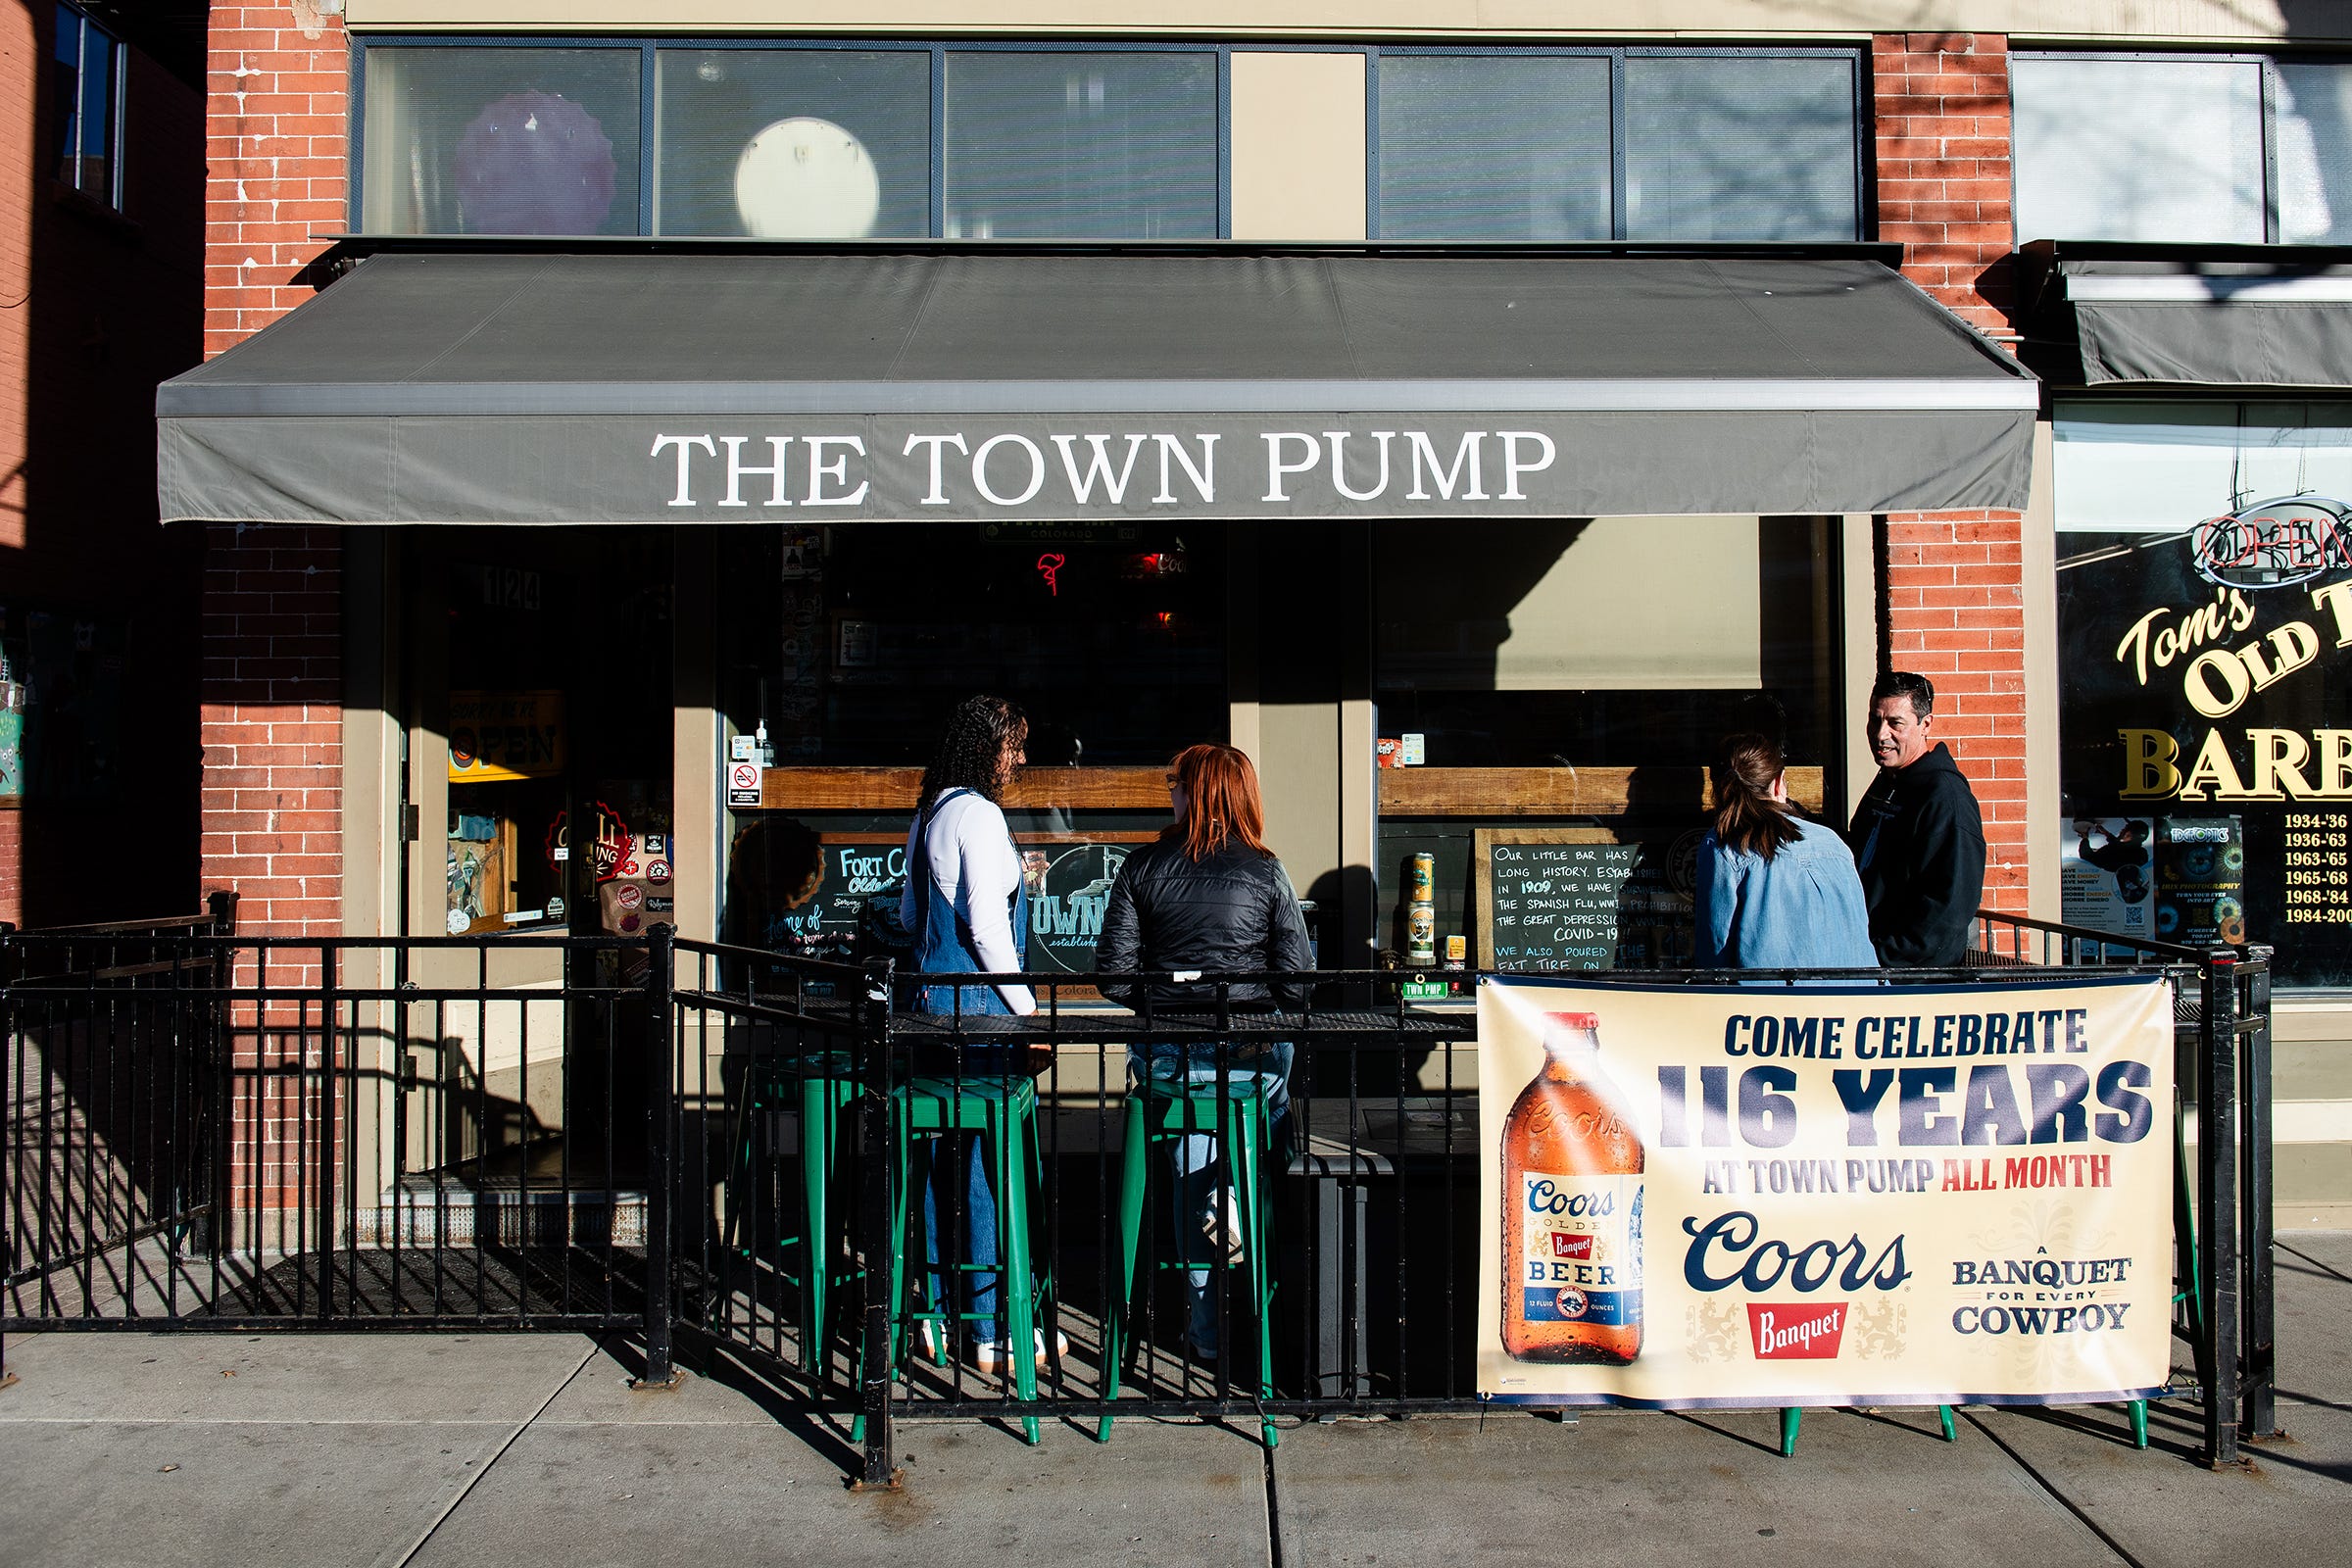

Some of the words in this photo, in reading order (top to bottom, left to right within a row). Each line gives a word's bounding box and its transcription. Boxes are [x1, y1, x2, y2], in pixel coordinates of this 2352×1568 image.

[650, 433, 870, 507] THE
[902, 432, 1221, 507] TOWN
[1260, 430, 1556, 502] PUMP
[2200, 516, 2352, 568] OPEN
[2116, 586, 2256, 686] Tom's
[2183, 620, 2320, 718] OLD
[450, 725, 557, 771] OPEN
[1377, 742, 1395, 755] enga
[2284, 813, 2348, 828] 1934-'36
[2284, 832, 2348, 847] 1936-'63
[839, 848, 884, 877] FORT
[1494, 848, 1523, 861] OUR
[1533, 851, 1568, 860] LITTLE
[1575, 851, 1596, 860] BAR
[1605, 851, 1629, 860] HAS
[2285, 852, 2348, 866] 1963-'65
[1497, 868, 1530, 878] LONG
[1543, 867, 1590, 878] HISTORY.
[2285, 870, 2348, 885] 1965-'68
[1497, 885, 1509, 894] IN
[1560, 883, 1580, 893] WE
[1587, 883, 1612, 893] HAVE
[2285, 890, 2349, 904] 1968-'84
[1031, 895, 1104, 936] OWN
[1497, 900, 1518, 910] THE
[1527, 899, 1570, 909] SPANISH
[1575, 899, 1596, 910] FLU,
[1630, 900, 1693, 912] PROHIBITIO
[807, 904, 823, 931] of
[1495, 916, 1517, 926] THE
[1523, 914, 1557, 926] GREAT
[1049, 935, 1099, 949] establishe
[1495, 946, 1517, 956] WE
[1525, 947, 1553, 956] ALSO
[1564, 947, 1608, 957] POURED
[1405, 984, 1424, 996] TWN
[1425, 984, 1442, 996] PMP
[1724, 1014, 1845, 1060] COME
[1854, 1008, 2088, 1060] CELEBRATE
[1657, 1064, 1797, 1149] 116
[1832, 1060, 2153, 1148] YEARS
[1523, 1100, 1624, 1143] Coors
[1703, 1159, 1741, 1194] AT
[1747, 1159, 1839, 1194] TOWN
[1845, 1158, 1935, 1194] PUMP
[1941, 1158, 1997, 1193] ALL
[2004, 1154, 2113, 1190] MONTH
[1528, 1179, 1615, 1217] Coors
[1528, 1217, 1603, 1230] GOLDE
[1555, 1236, 1592, 1255] Banquet
[1682, 1210, 1913, 1293] Coors
[2036, 1246, 2047, 1254] A
[1528, 1261, 1616, 1285] BEER
[1952, 1257, 2132, 1290] BANQUET
[1985, 1292, 2025, 1300] FOR
[2035, 1290, 2096, 1301] EVERY
[1952, 1303, 2132, 1335] COWBOY
[1759, 1307, 1840, 1355] Banquet
